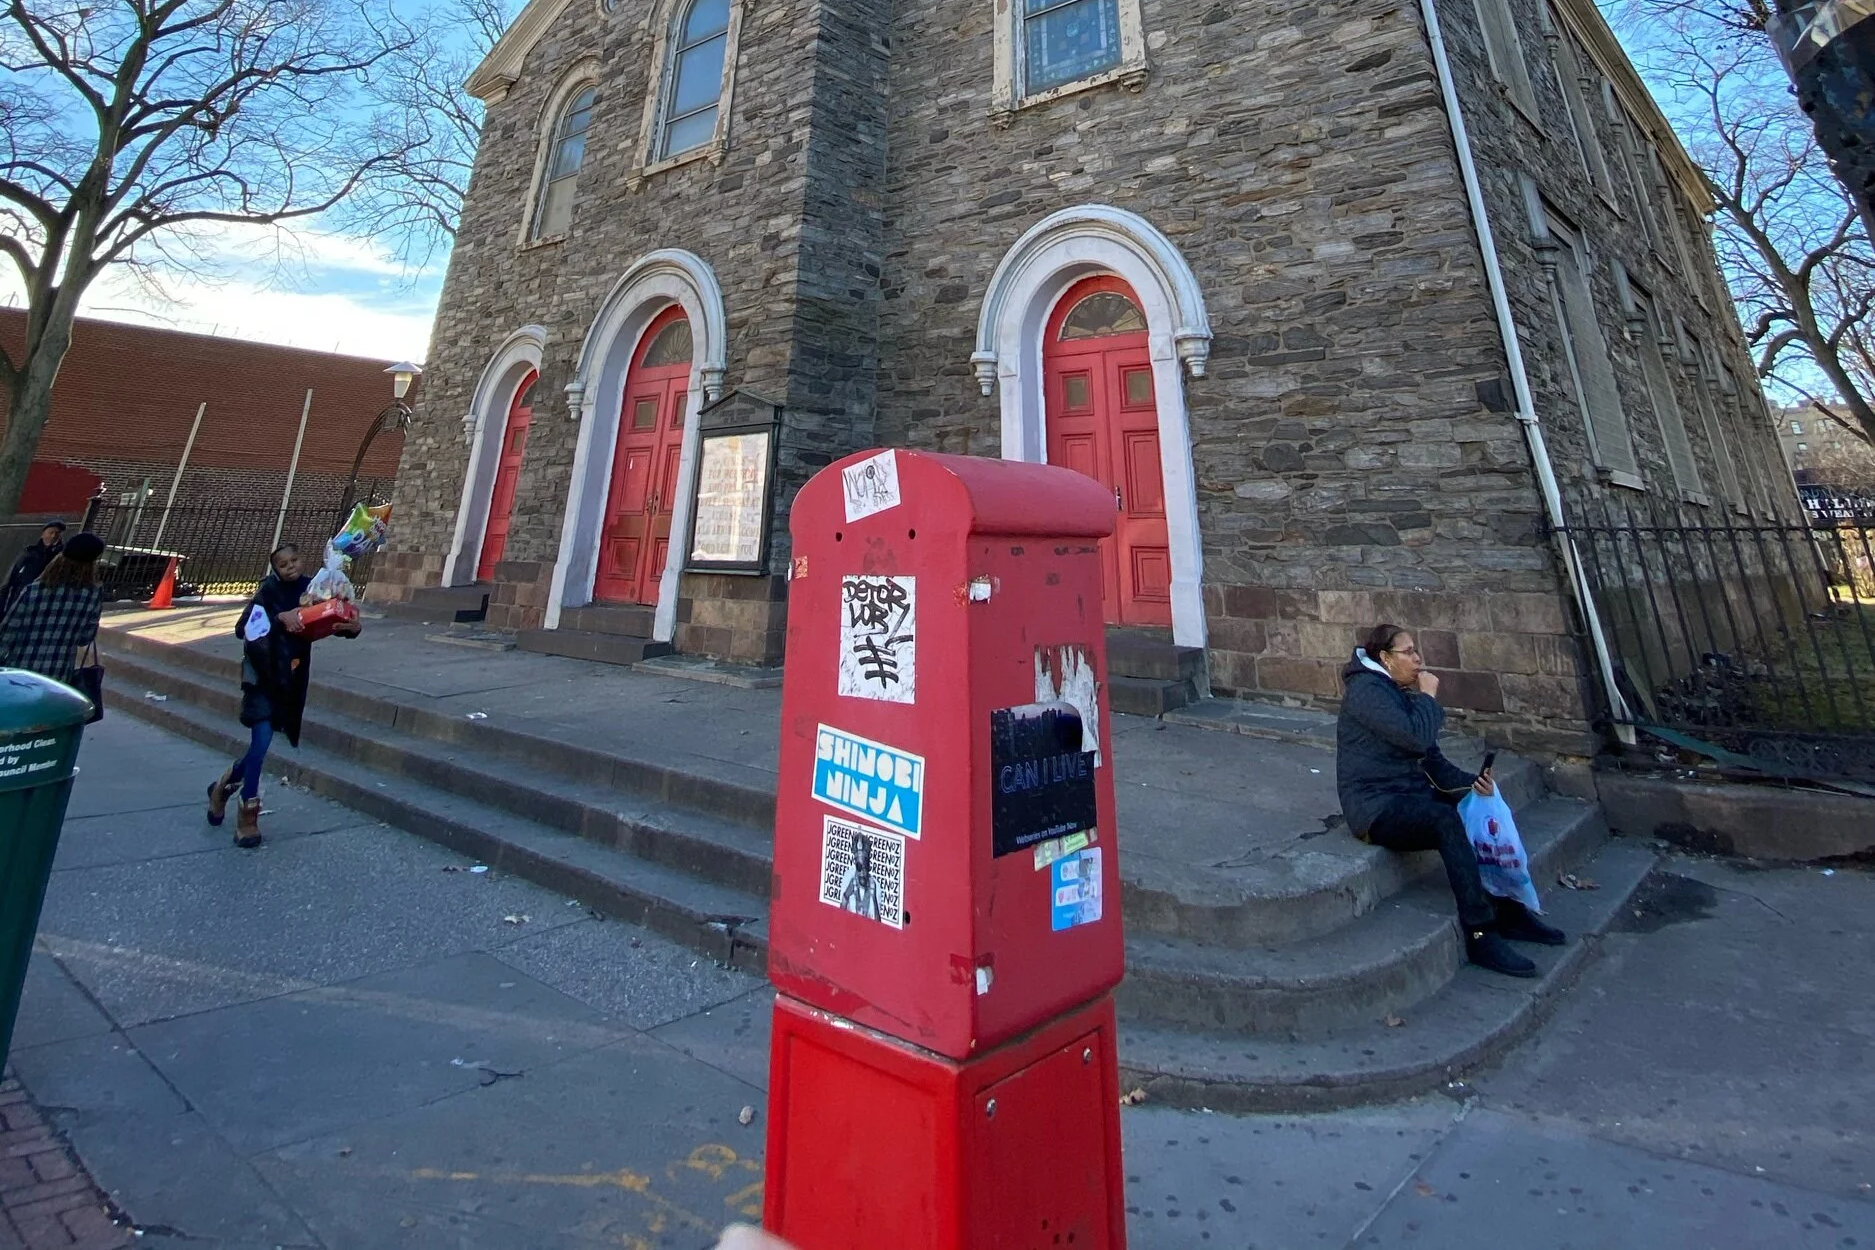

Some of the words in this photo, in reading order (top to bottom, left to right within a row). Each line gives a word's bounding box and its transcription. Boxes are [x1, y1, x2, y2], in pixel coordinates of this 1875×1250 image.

[8, 755, 20, 766] by
[28, 759, 58, 773] Member
[818, 732, 920, 794] SHINOBI
[1000, 759, 1039, 794] CAN
[1042, 756, 1049, 785] I
[1052, 752, 1088, 784] LIVE
[825, 768, 904, 824] NINJA
